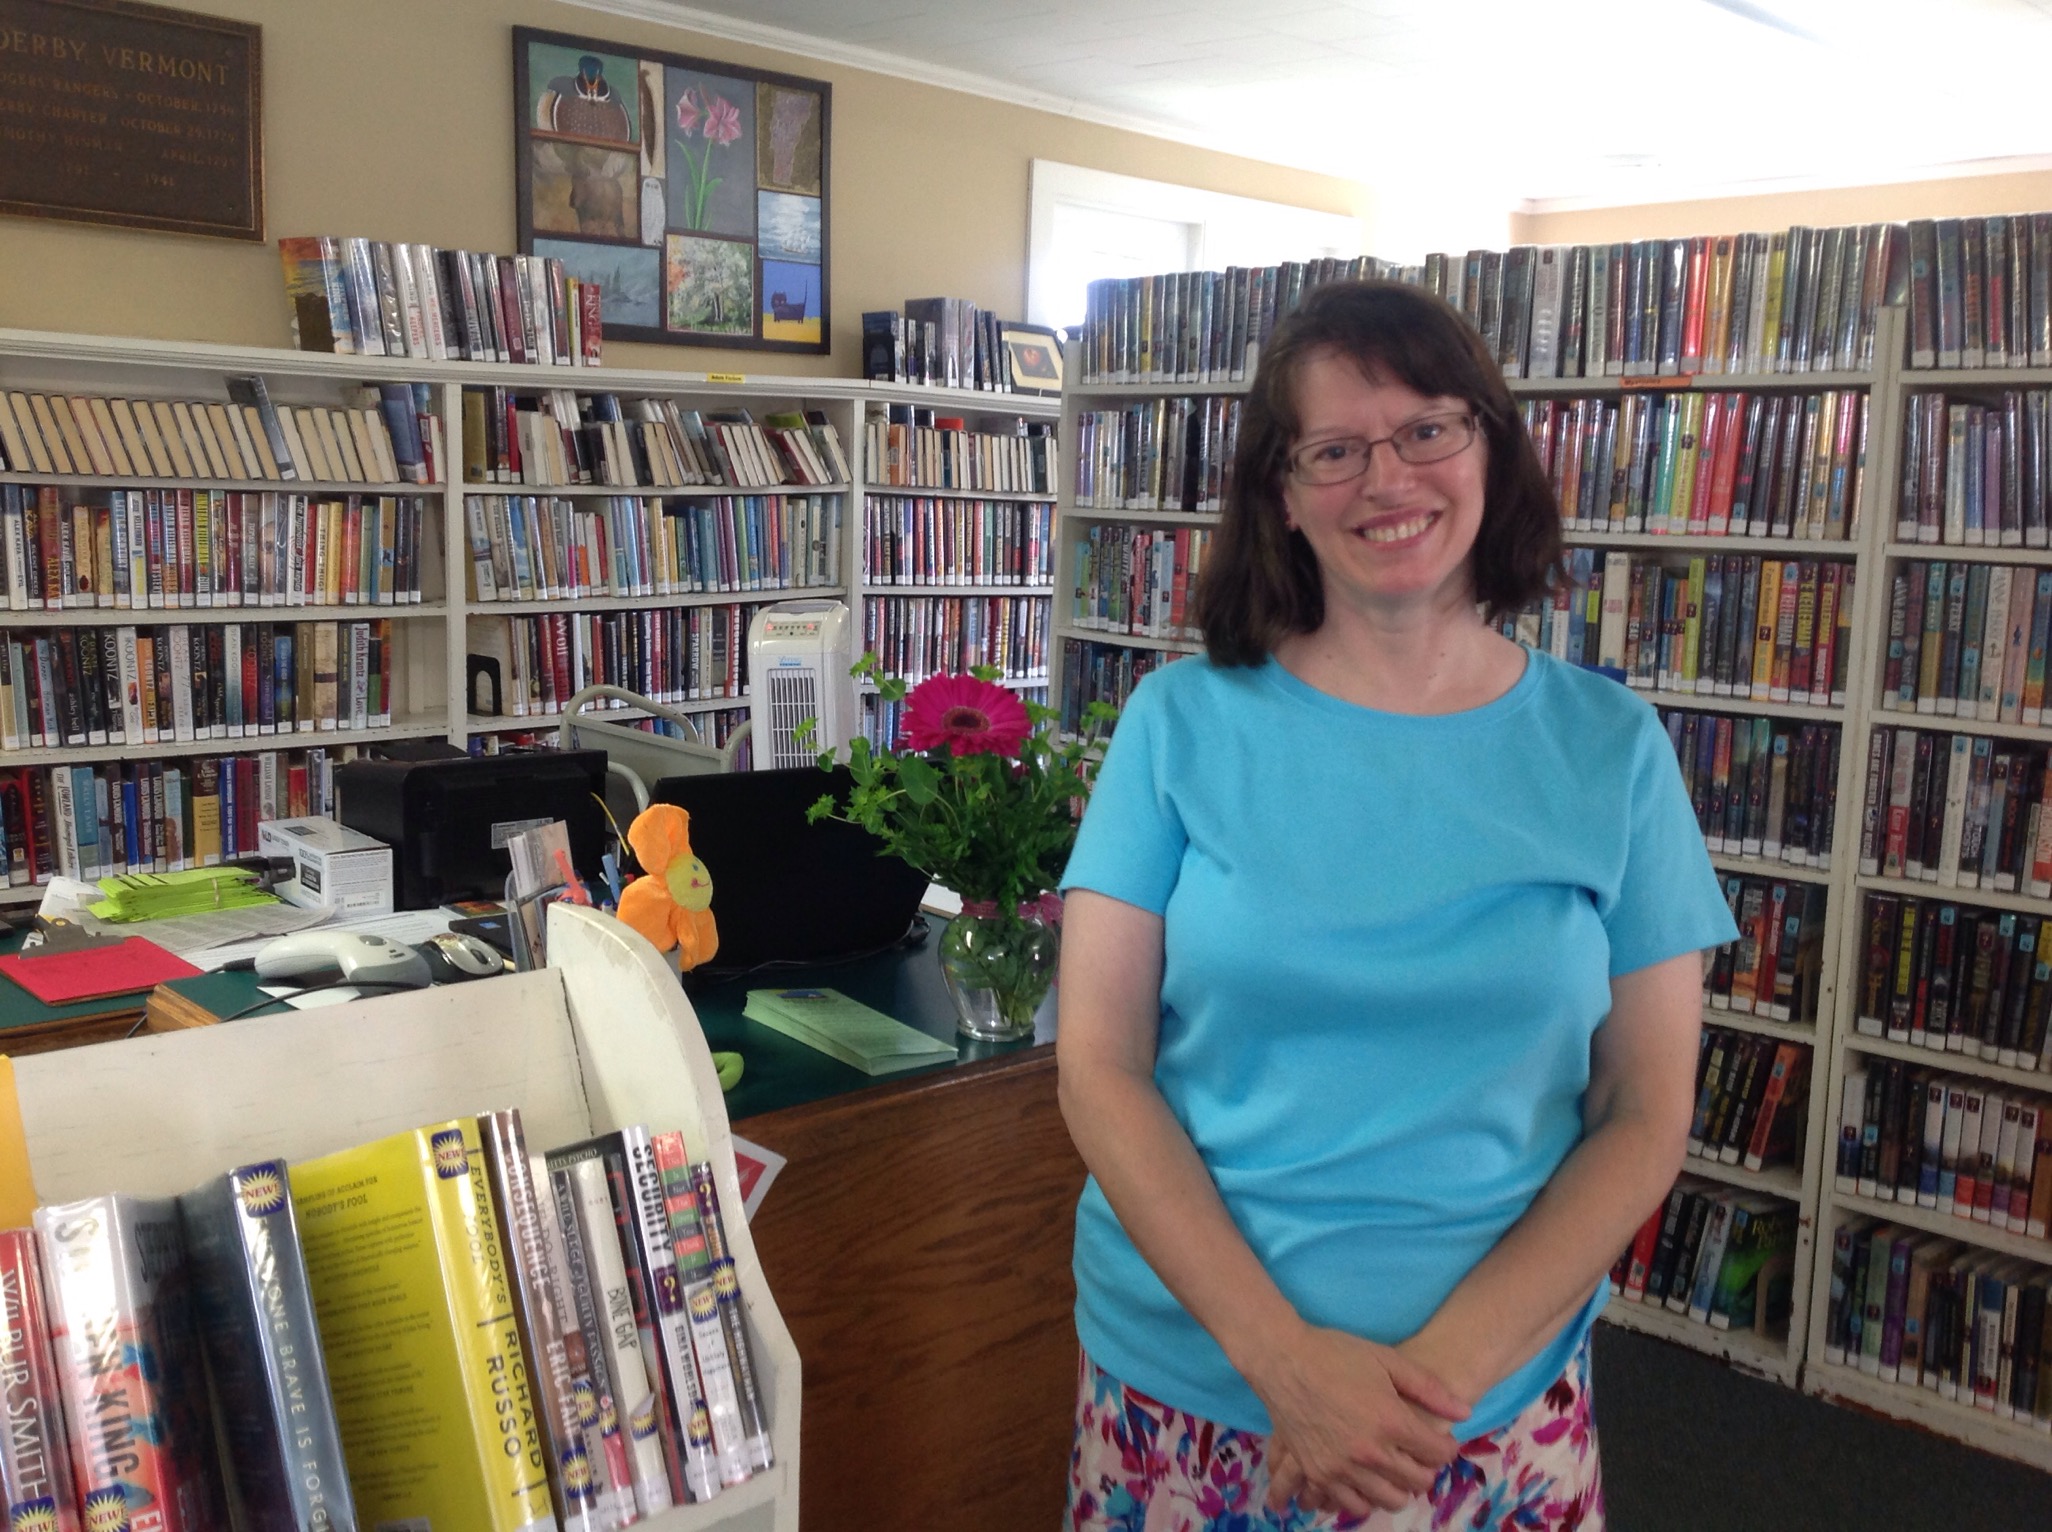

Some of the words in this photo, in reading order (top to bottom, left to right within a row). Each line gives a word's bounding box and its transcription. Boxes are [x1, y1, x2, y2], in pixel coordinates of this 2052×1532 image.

[102, 43, 231, 86] VERMONT
[43, 103, 108, 125] CHARTER
[121, 117, 181, 136] OCTOBER
[331, 281, 341, 304] KING
[431, 312, 442, 347] MERCEDES
[115, 500, 127, 530] LITTLE
[61, 521, 71, 541] ALEX
[134, 515, 143, 547] KELLERMAN
[197, 527, 210, 564] KELLERMAN
[295, 515, 304, 549] hypnotist
[62, 541, 73, 561] KAVA
[117, 532, 129, 569] CENTURY
[47, 557, 61, 581] ALEX
[1777, 593, 1797, 646] KELLERMAN
[1796, 591, 1815, 648] KELLERMAN
[1820, 591, 1835, 645] KELLERMAN
[157, 637, 165, 671] KOONTZ
[193, 637, 202, 672] KOONTZ
[260, 631, 269, 668] KOONTZ
[355, 627, 368, 651] Judith
[691, 633, 700, 670] SPARROW
[104, 634, 118, 682] KOONTZ
[124, 638, 137, 681] KOONTZ
[355, 652, 368, 677] Krantz
[144, 659, 153, 690] KOONTZ
[67, 693, 79, 717] ashley
[71, 717, 80, 732] bell
[1872, 734, 1883, 758] BONES
[56, 773, 65, 785] THE
[263, 755, 273, 780] WILLIAM
[82, 780, 91, 806] WALLY
[111, 781, 121, 799] LOUIS
[140, 777, 150, 795] LOUIS
[152, 776, 162, 794] LOUIS
[1867, 774, 1880, 805] FOREVER
[60, 786, 73, 817] LOWLAND
[85, 809, 93, 834] LAMB
[1970, 827, 1982, 858] TOUCH
[437, 1148, 465, 1163] NEW!
[567, 1147, 599, 1166] PSYCHO
[244, 1183, 279, 1199] NEW!
[337, 1179, 364, 1194] ACCLAIM
[365, 1175, 378, 1186] FOR
[635, 1144, 673, 1252] SECURITY
[673, 1184, 690, 1194] Not
[305, 1199, 346, 1220] NOBODY'S
[346, 1193, 369, 1209] FOOL
[508, 1150, 551, 1290] CONSEQUENCE
[470, 1165, 508, 1305] EVERYBODY'S
[1, 1269, 30, 1397] WILBUR
[616, 1320, 638, 1350] GAP
[546, 1339, 571, 1389] ERIC
[587, 1330, 607, 1389] PASSION
[279, 1345, 305, 1414] BRAVE
[295, 1427, 313, 1449] IS
[486, 1354, 522, 1459] RUSSO
[504, 1330, 543, 1469] RICHARD
[90, 1386, 140, 1477] KING
[6, 1396, 47, 1499] SMITH
[89, 1504, 126, 1528] NEW!
